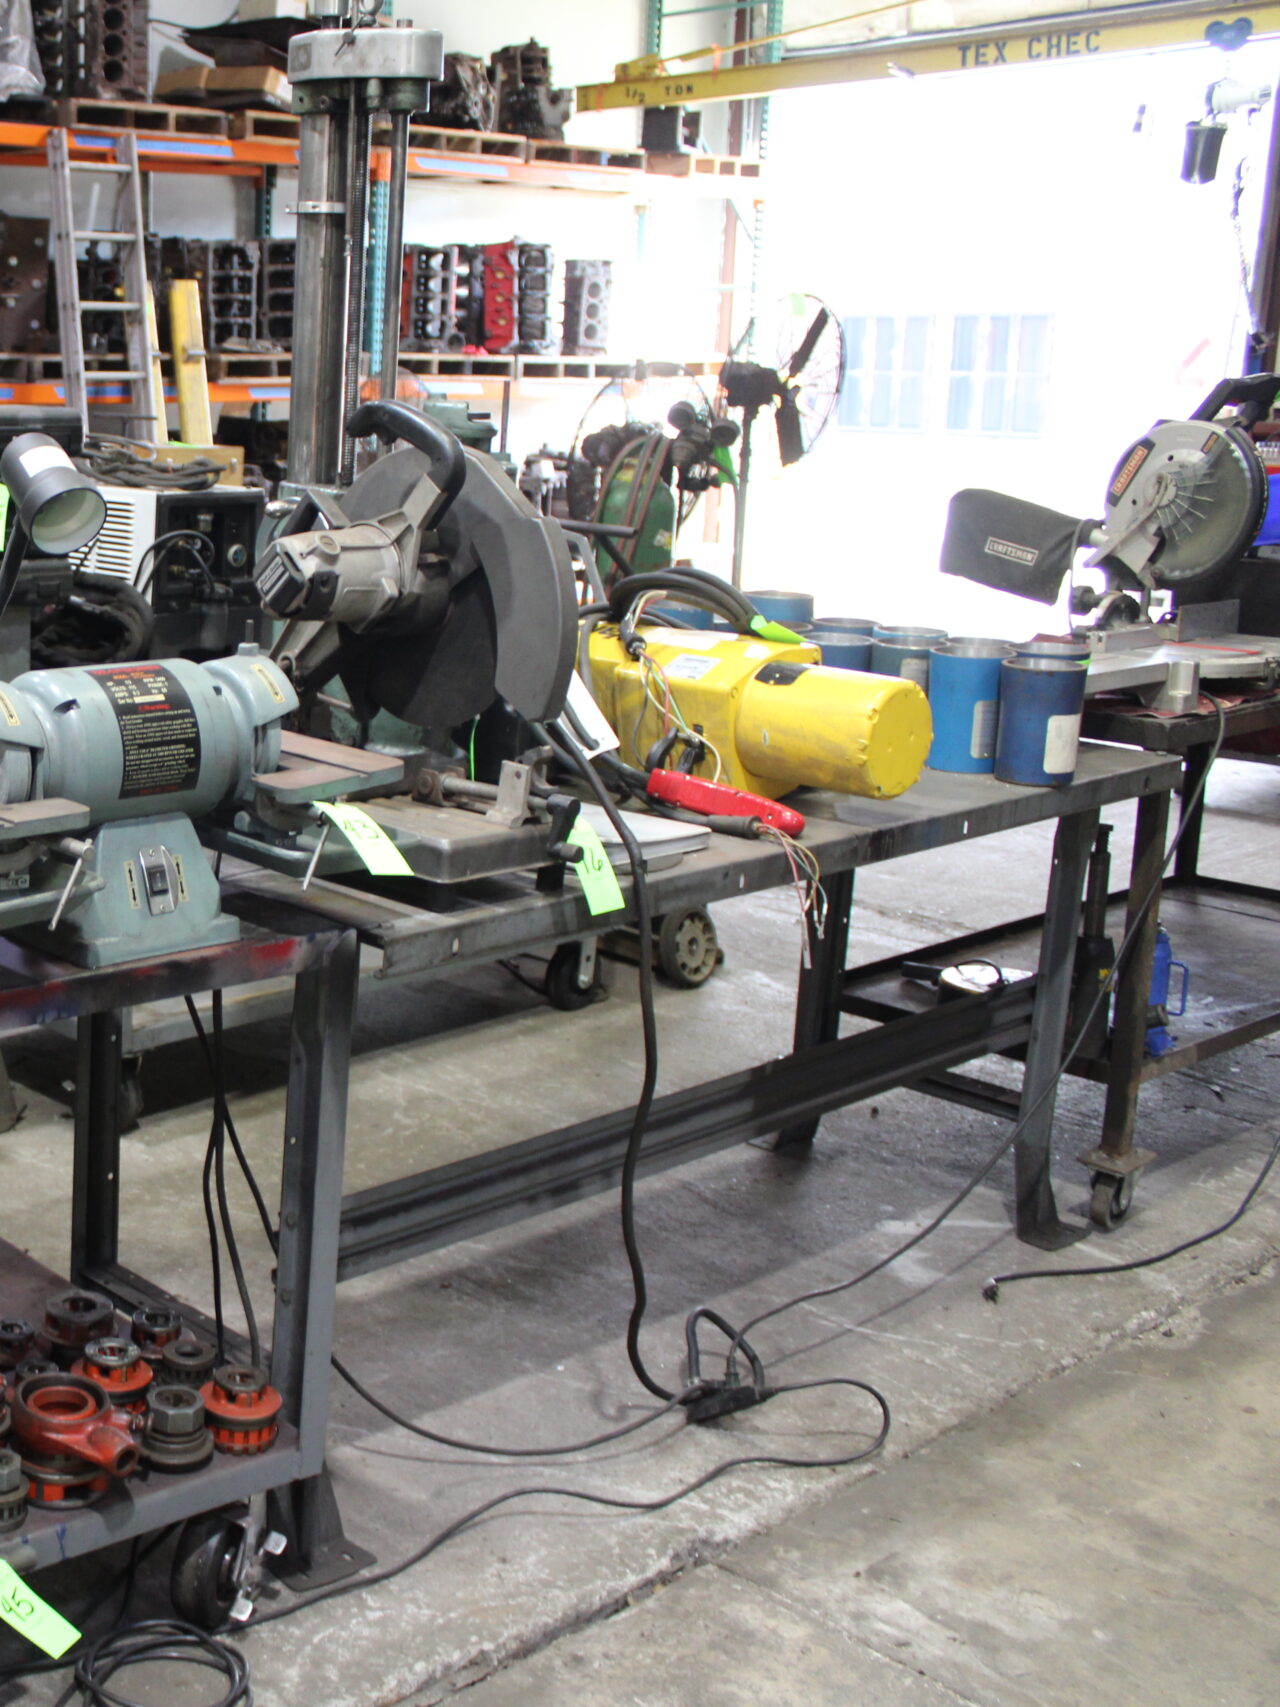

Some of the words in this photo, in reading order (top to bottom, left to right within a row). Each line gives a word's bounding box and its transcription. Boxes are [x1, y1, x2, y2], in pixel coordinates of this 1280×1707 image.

[958, 41, 1008, 68] TEX
[1027, 30, 1102, 60] CHEC
[665, 84, 694, 96] TON
[1111, 446, 1145, 495] CRAFTSMAN
[343, 819, 381, 839] 43
[1, 1586, 34, 1623] 45
